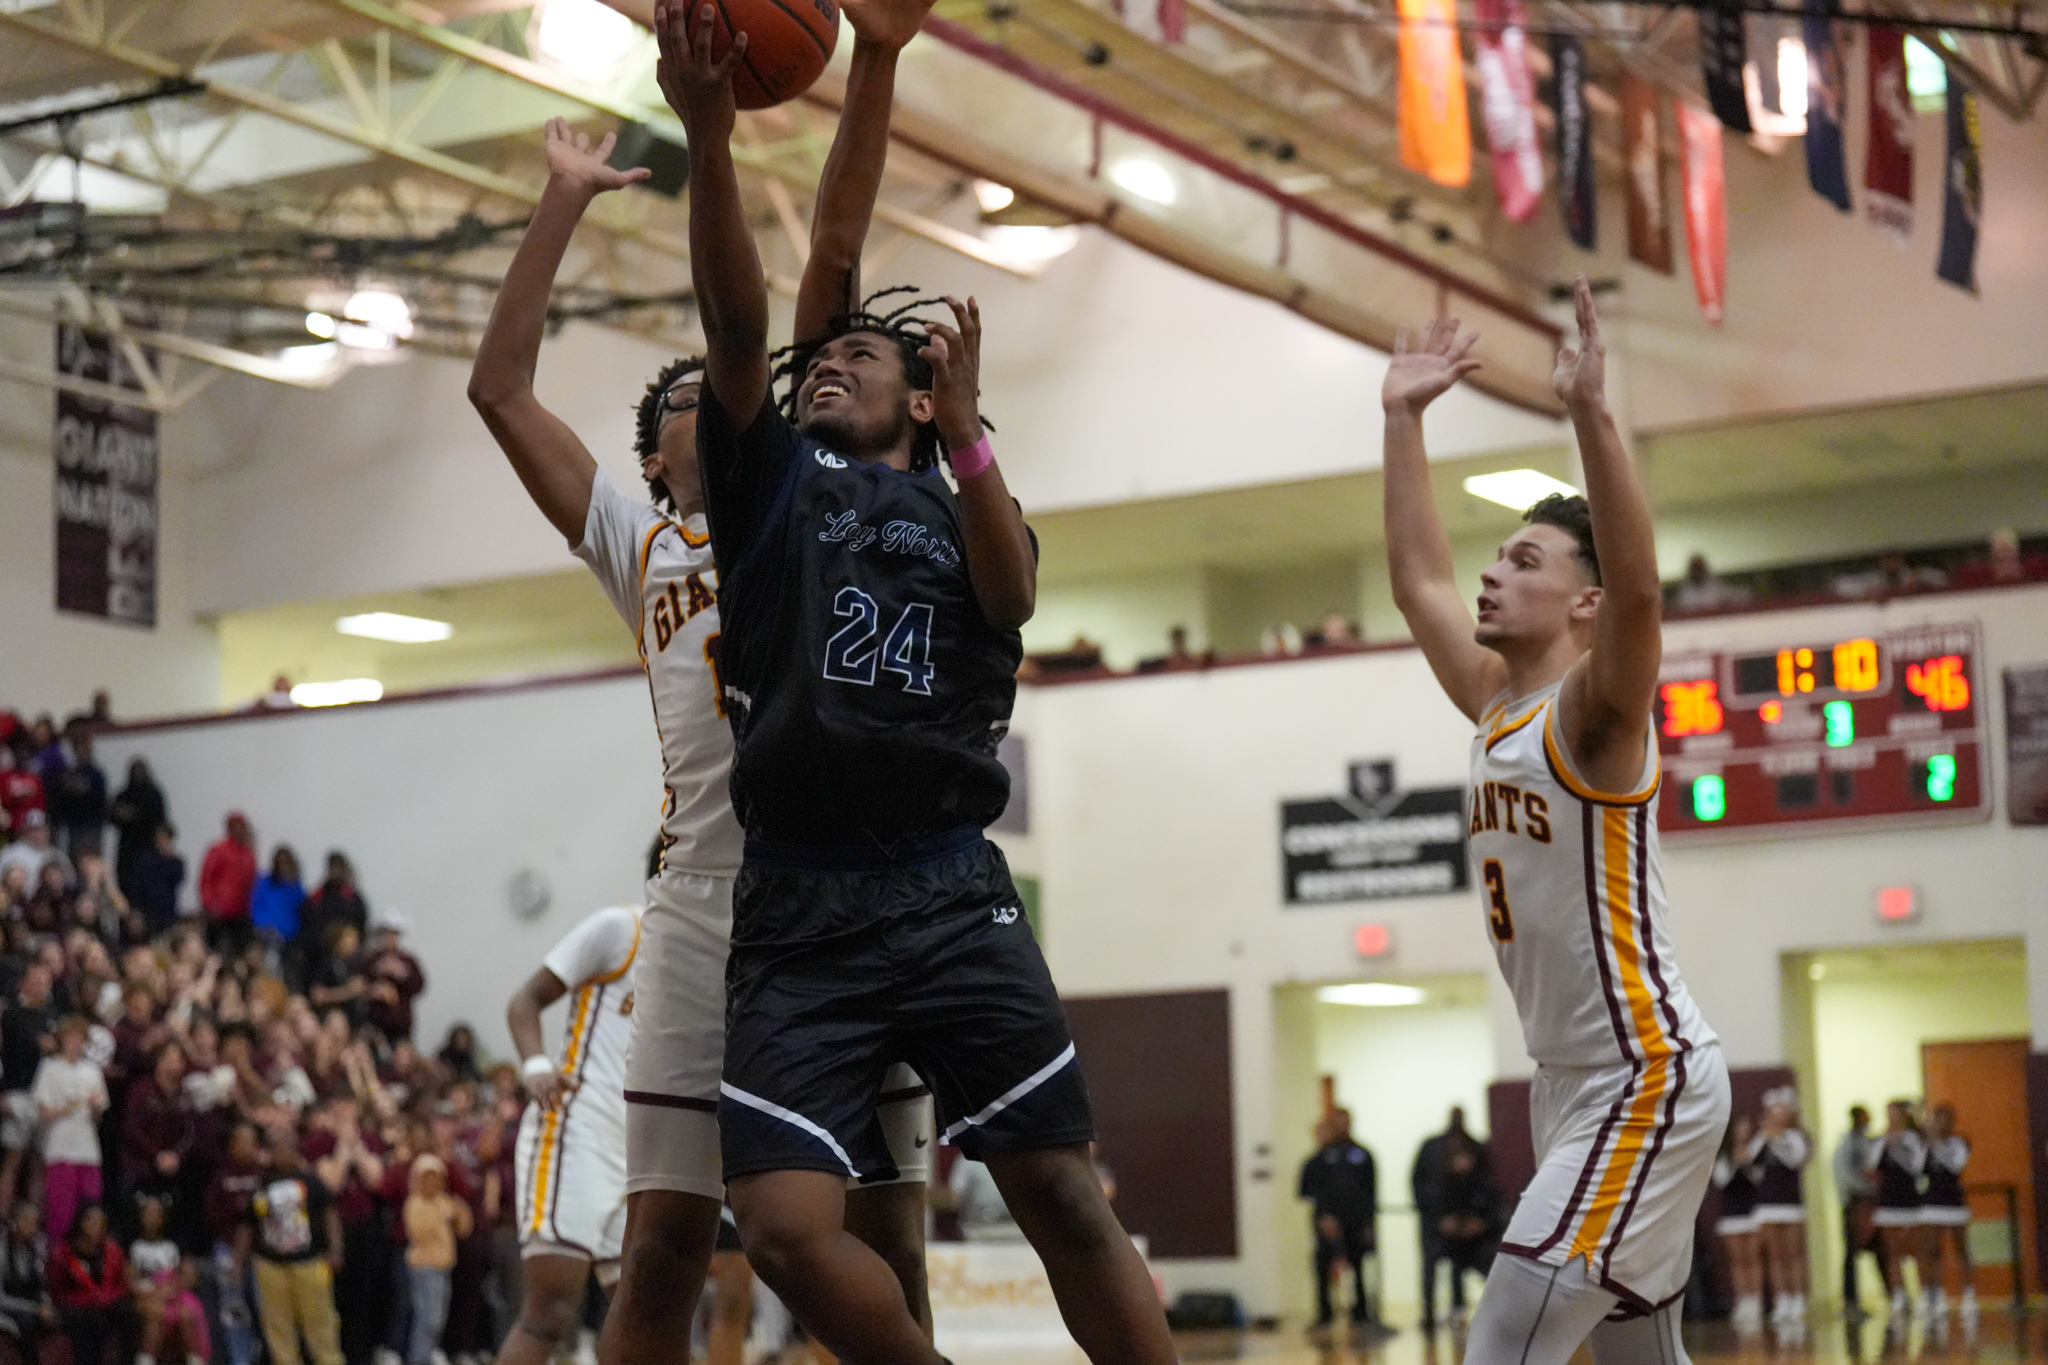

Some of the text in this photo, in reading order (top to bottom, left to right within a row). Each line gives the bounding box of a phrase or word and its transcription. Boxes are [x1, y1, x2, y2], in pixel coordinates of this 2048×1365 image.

[819, 509, 876, 551] Loy
[653, 561, 721, 653] GIA
[823, 586, 935, 696] 24
[1776, 638, 1879, 697] 1:10
[1660, 679, 1724, 737] 36
[1905, 654, 1970, 712] 46
[1469, 781, 1552, 844] ANTS
[1484, 858, 1514, 943] 3
